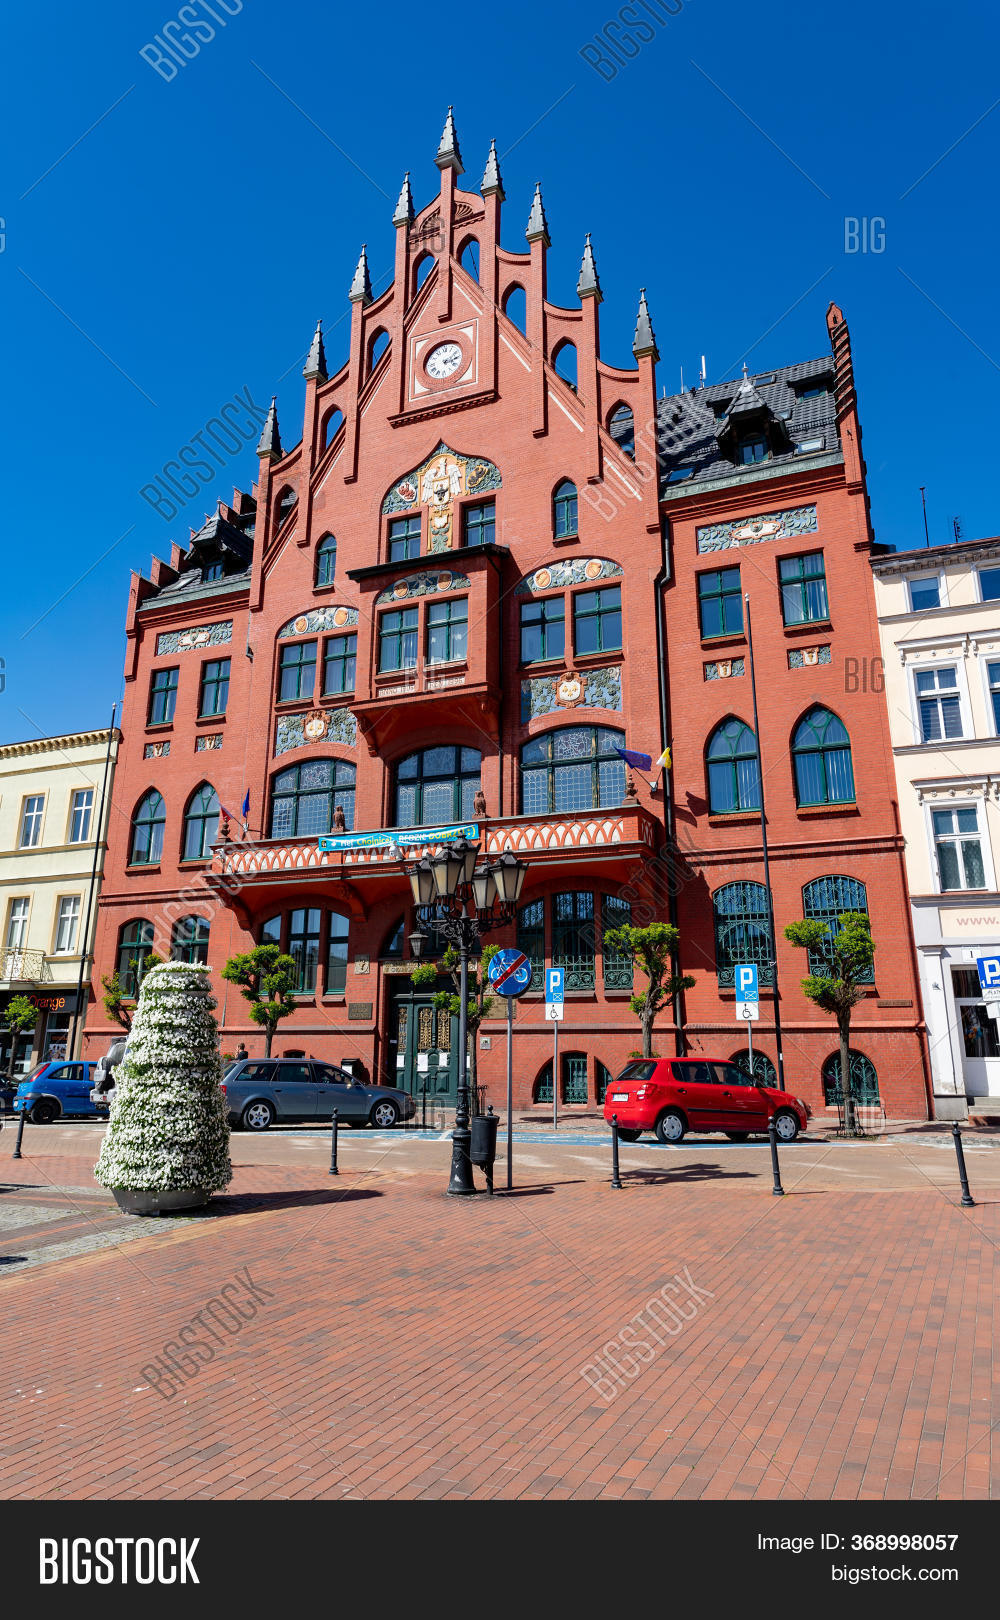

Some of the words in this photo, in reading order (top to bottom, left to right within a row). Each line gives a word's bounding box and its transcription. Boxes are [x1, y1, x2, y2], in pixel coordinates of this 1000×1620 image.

[550, 971, 561, 992] P
[740, 967, 753, 991] P
[29, 995, 65, 1011] Orange
